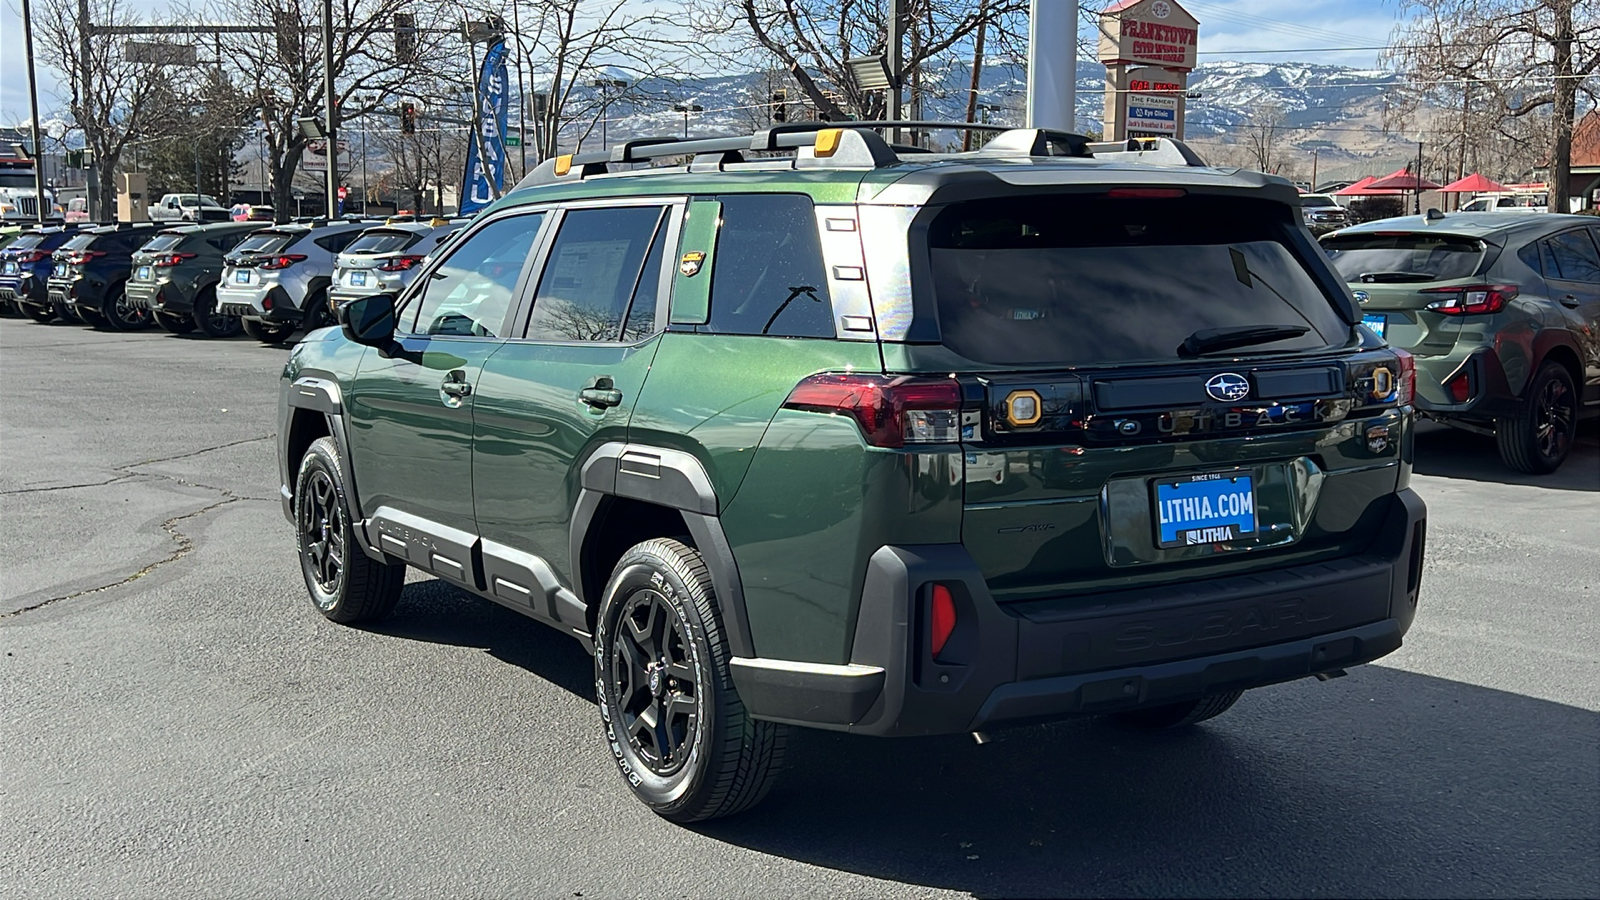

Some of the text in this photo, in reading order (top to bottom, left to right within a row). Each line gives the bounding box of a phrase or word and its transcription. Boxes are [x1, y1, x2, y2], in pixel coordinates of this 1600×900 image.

[1122, 20, 1197, 46] FRANKTOWN
[1133, 40, 1185, 63] CORNERS
[1131, 79, 1180, 94] CAR WASH
[1154, 110, 1169, 118] Clinic
[470, 73, 503, 204] SUBARU
[1118, 405, 1327, 436] OUTBACK
[1191, 474, 1208, 482] SINCE
[1159, 491, 1253, 524] LITHIA.COM
[379, 520, 437, 550] OUTBACK
[1197, 526, 1233, 544] LITHIA
[1115, 595, 1335, 652] SUBARU
